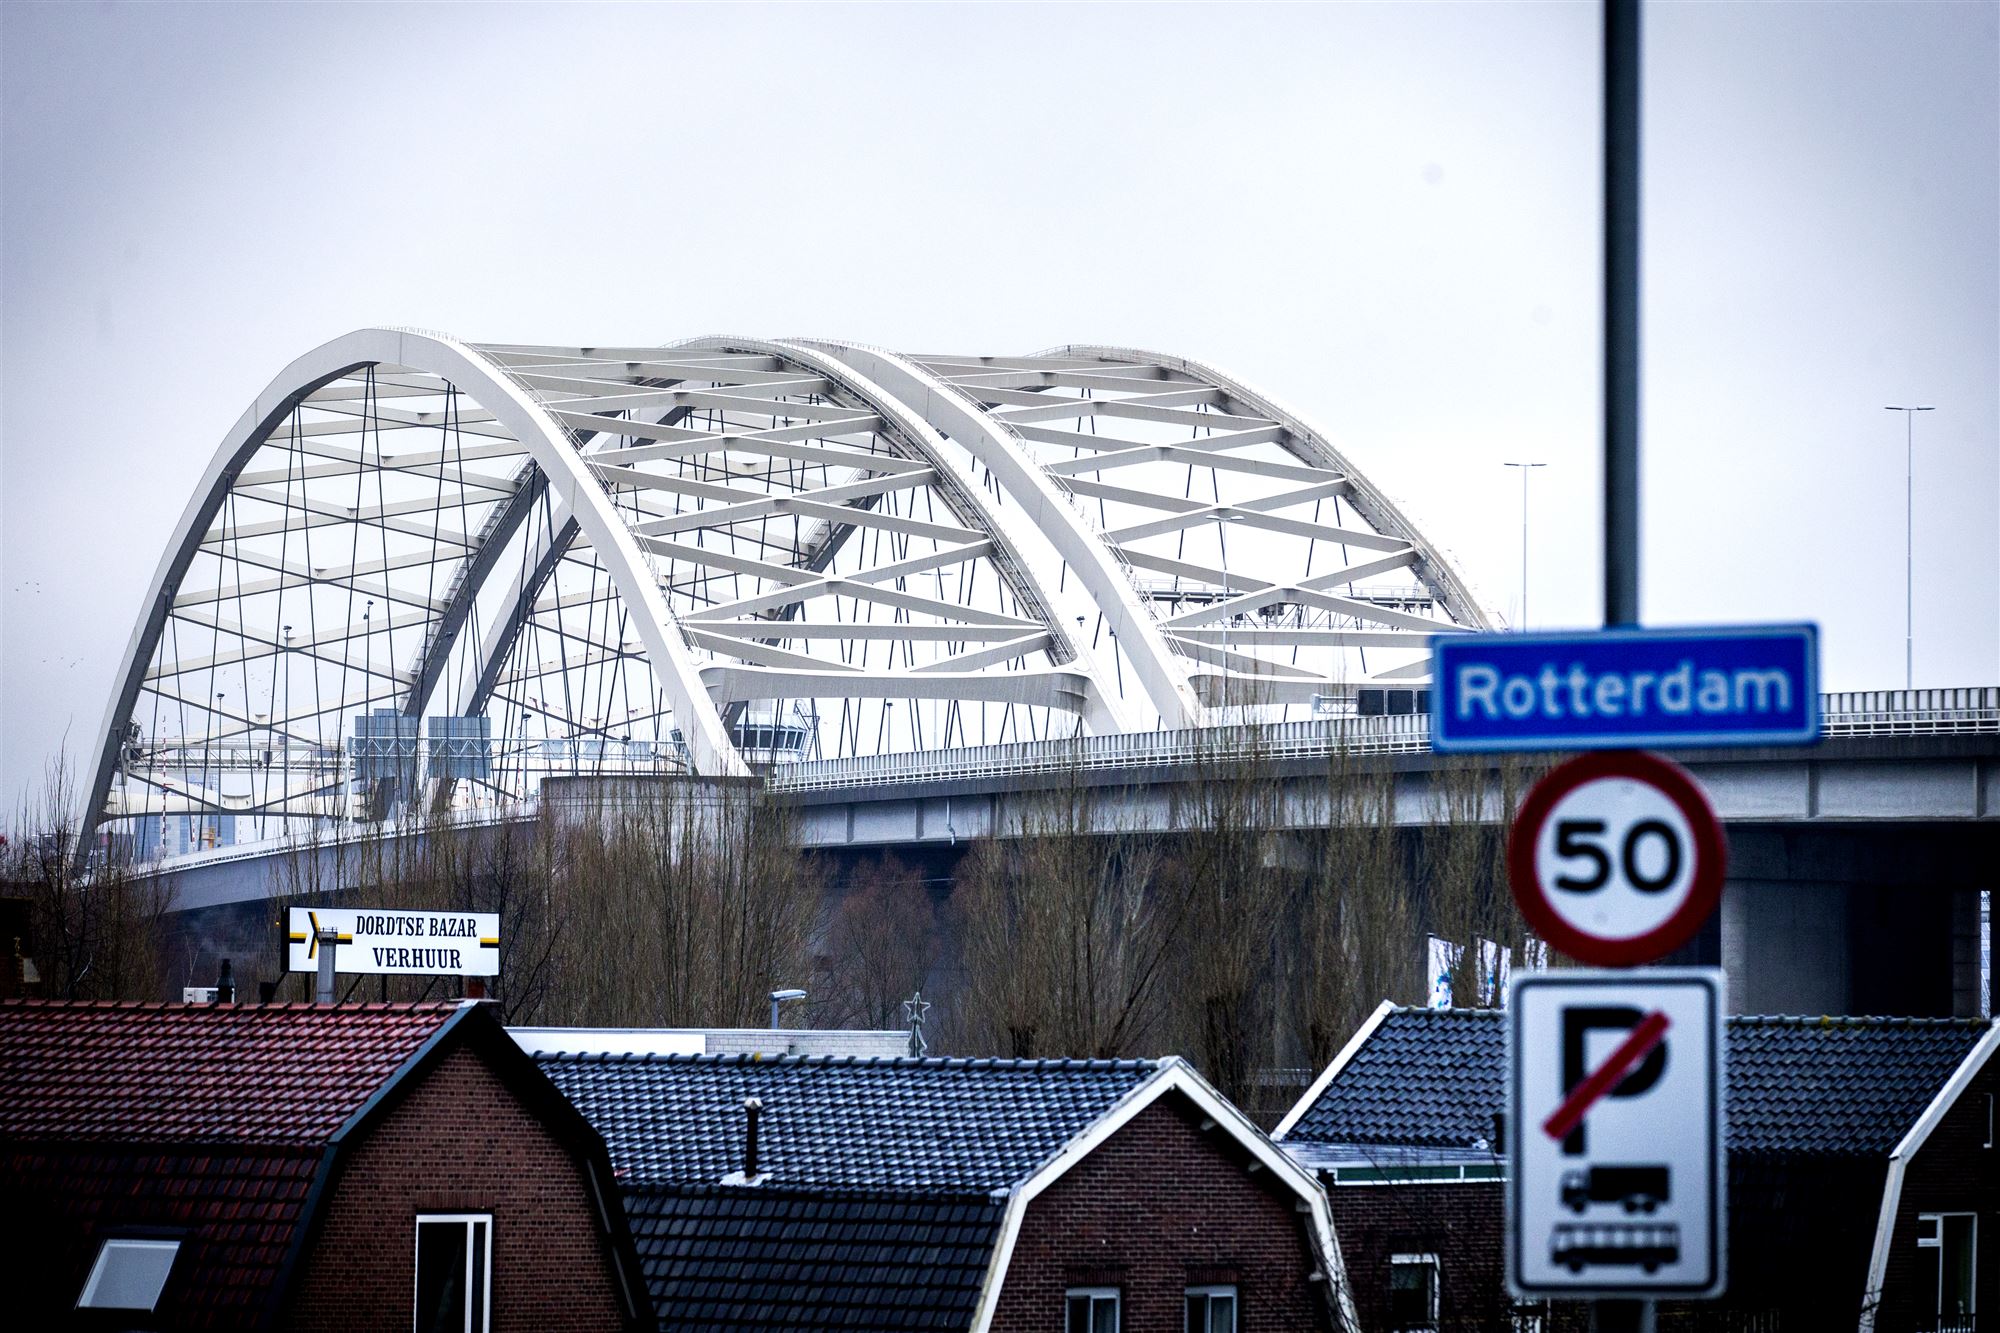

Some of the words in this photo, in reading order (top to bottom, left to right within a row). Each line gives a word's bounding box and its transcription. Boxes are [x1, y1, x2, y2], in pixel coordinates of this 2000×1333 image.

[1457, 661, 1792, 718] Rotterdam
[1554, 817, 1683, 893] 50
[355, 915, 424, 936] DORDTSE
[429, 918, 477, 937] BAZAR
[373, 947, 462, 968] VERHUUR
[1561, 1005, 1670, 1157] P
